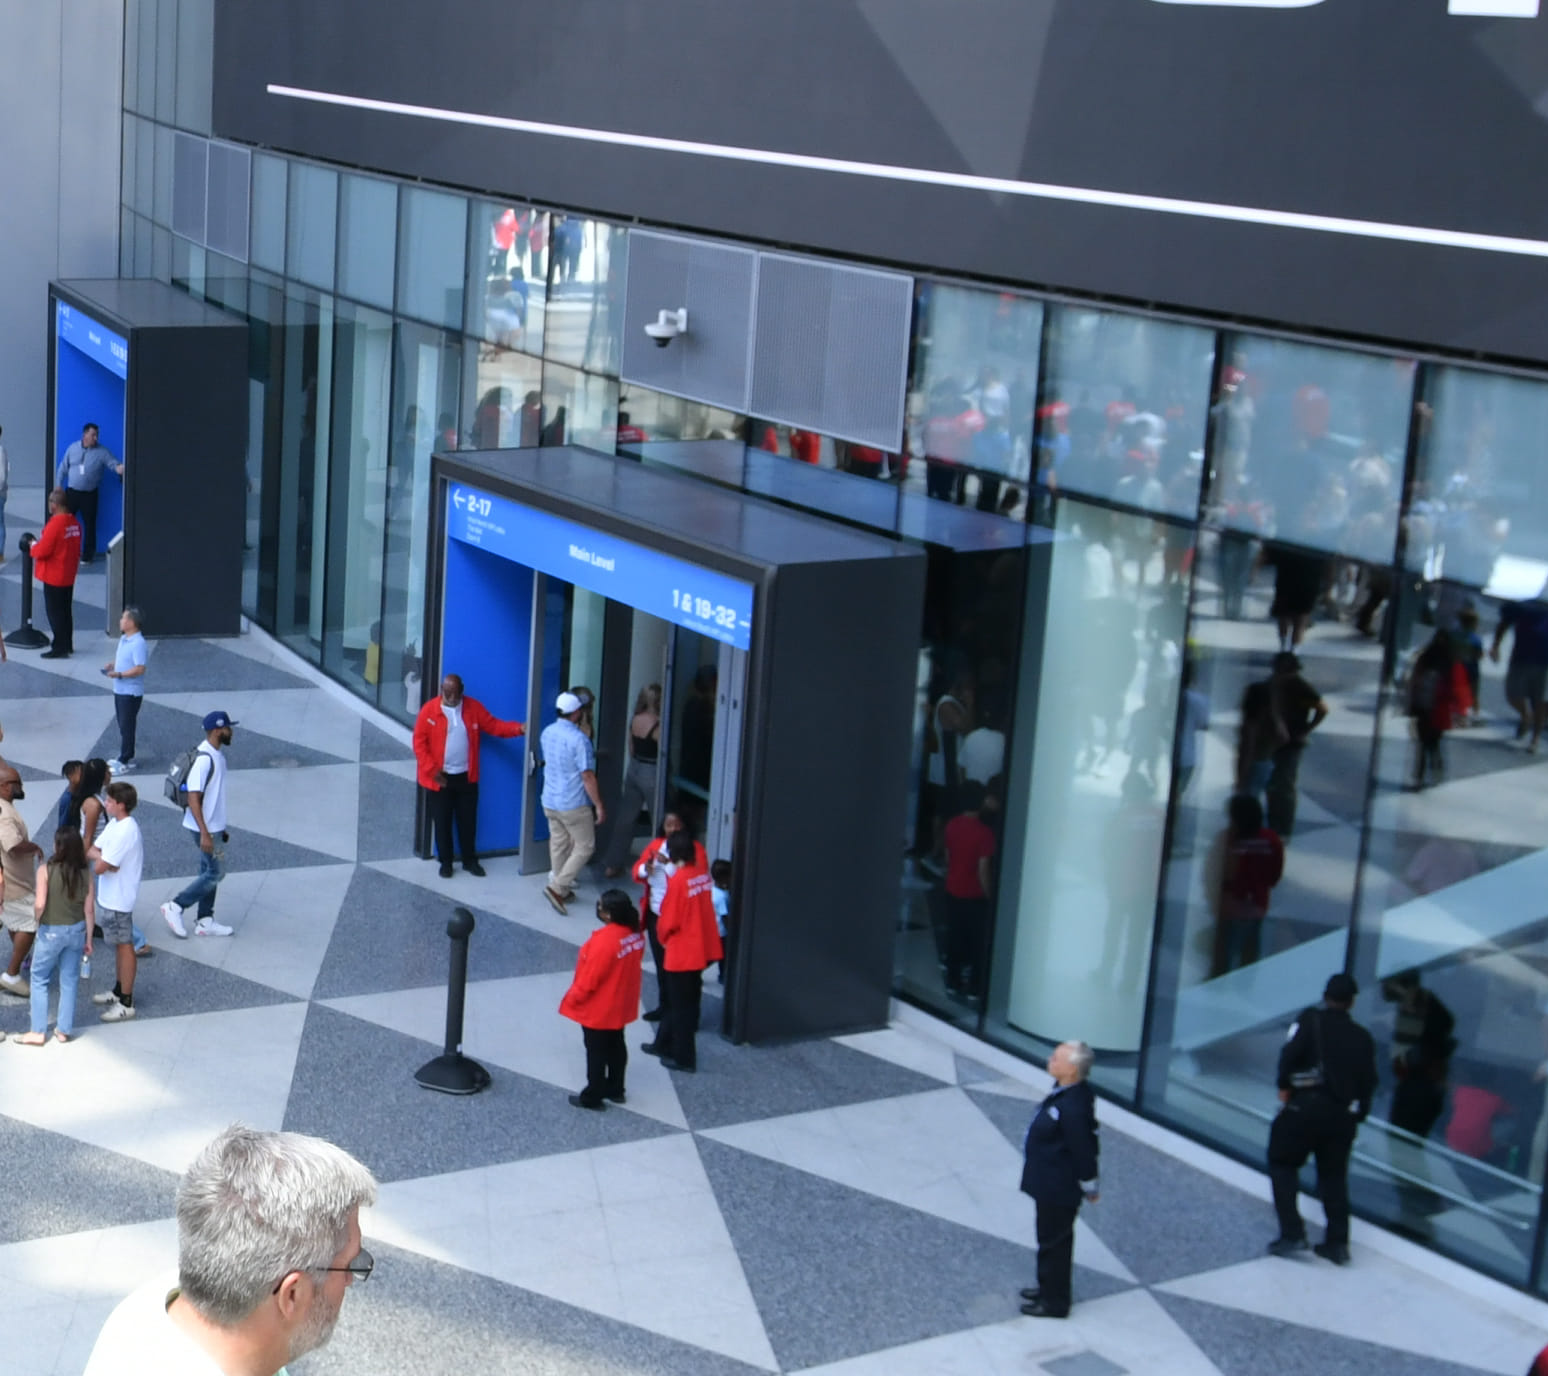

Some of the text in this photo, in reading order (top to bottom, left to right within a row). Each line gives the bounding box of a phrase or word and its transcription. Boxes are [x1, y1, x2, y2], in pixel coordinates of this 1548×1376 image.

[467, 494, 492, 516] 2-17
[569, 544, 615, 572] Main Level
